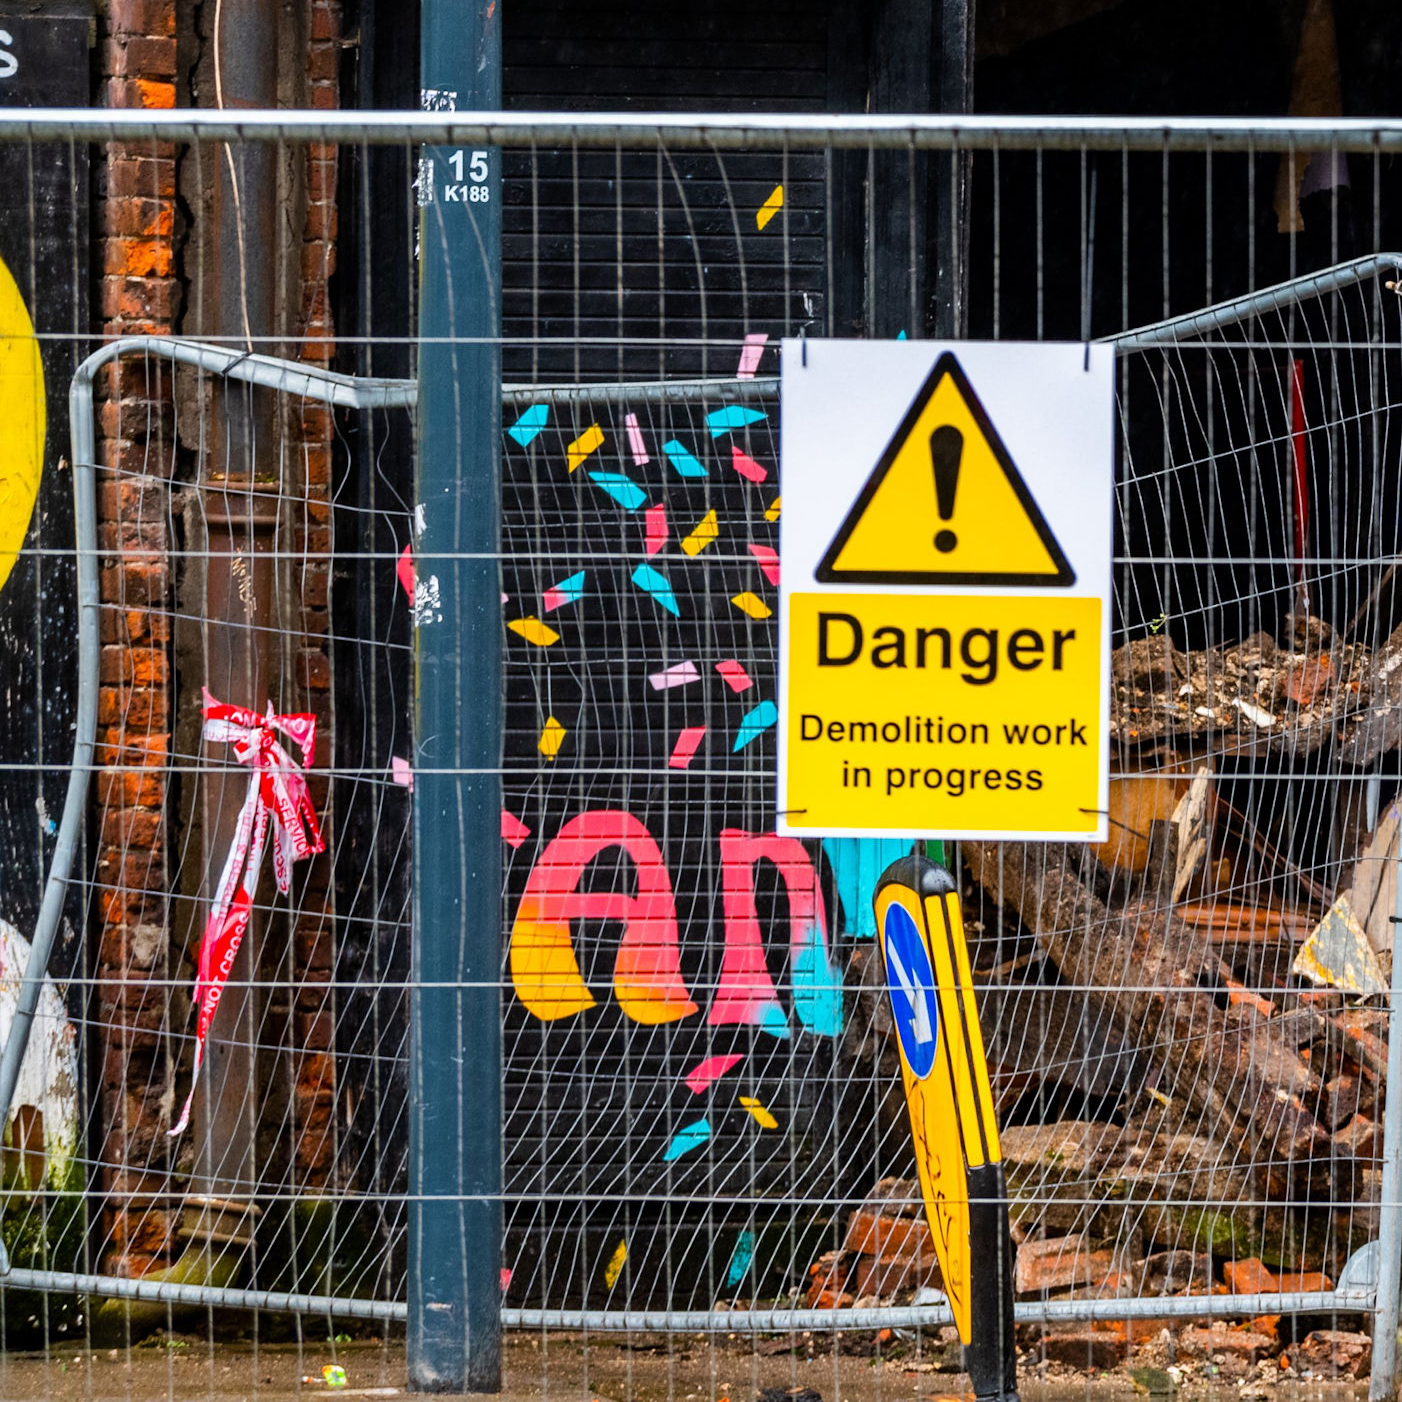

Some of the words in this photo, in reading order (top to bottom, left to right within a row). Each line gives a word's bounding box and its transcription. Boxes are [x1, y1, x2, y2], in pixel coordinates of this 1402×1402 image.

[448, 150, 489, 183] 15
[444, 185, 490, 203] K188
[817, 612, 1077, 686] Danger
[800, 714, 989, 746] Demolition
[1004, 717, 1089, 747] work
[843, 761, 872, 788] in
[886, 763, 1044, 797] progress
